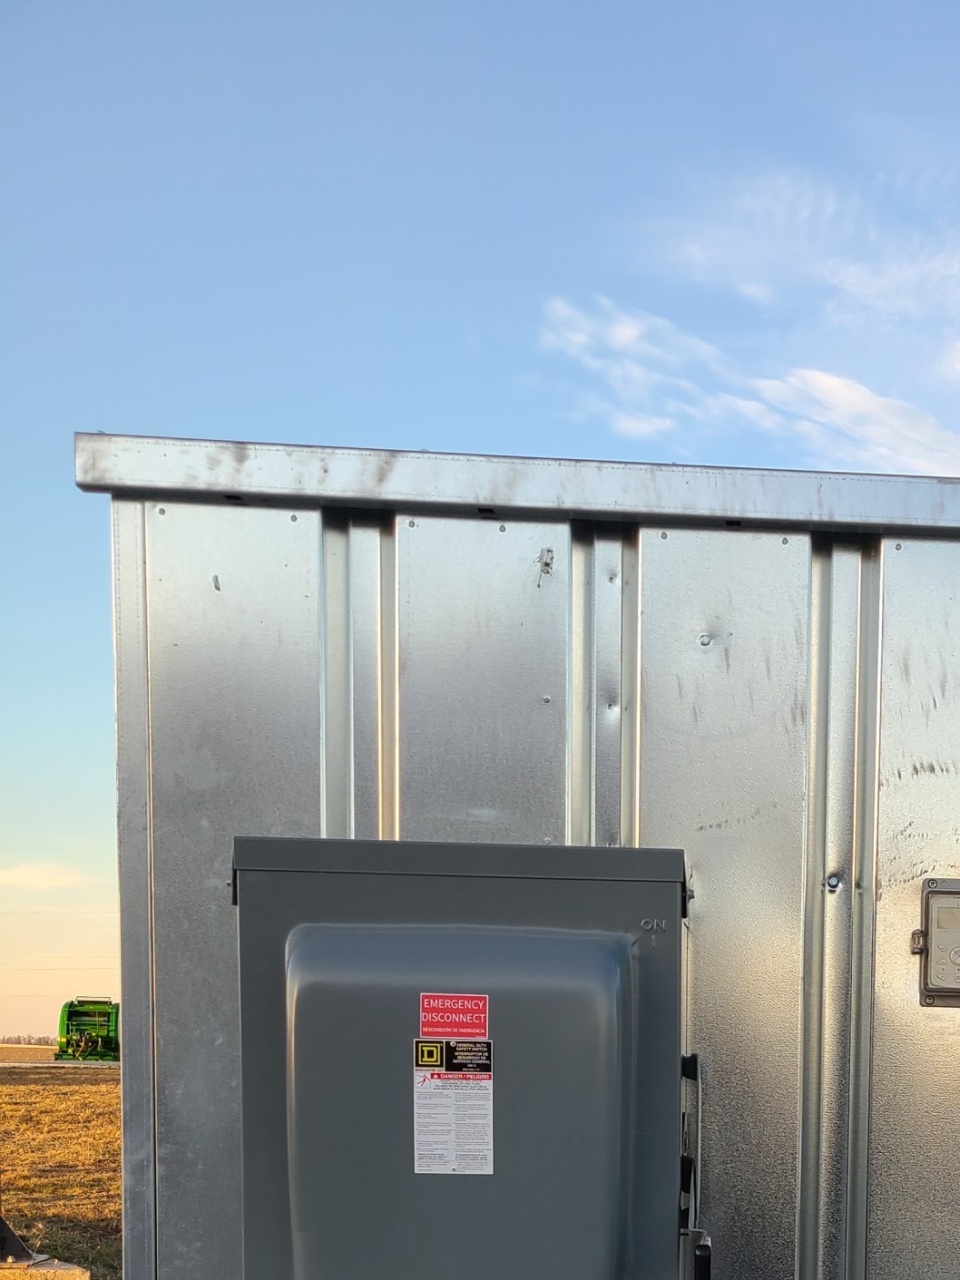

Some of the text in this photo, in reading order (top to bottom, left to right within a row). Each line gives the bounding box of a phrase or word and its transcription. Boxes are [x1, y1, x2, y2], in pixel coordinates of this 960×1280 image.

[640, 918, 667, 932] ON
[423, 998, 485, 1010] EMERGENCY
[421, 1012, 486, 1023] DISCONNECT
